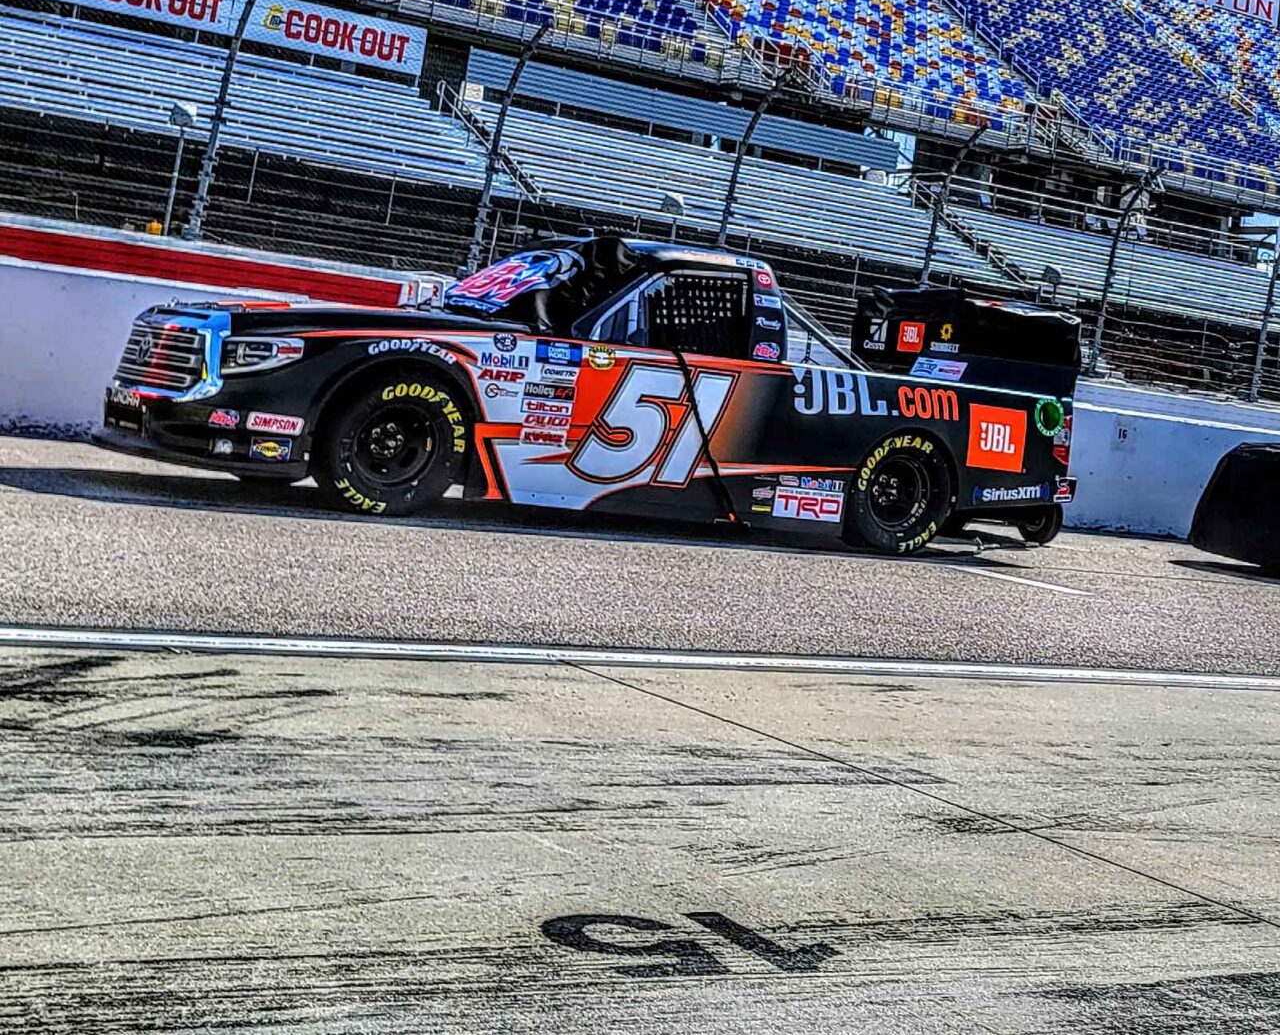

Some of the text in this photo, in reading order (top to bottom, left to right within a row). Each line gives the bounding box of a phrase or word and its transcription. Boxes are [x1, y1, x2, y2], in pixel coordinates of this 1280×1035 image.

[284, 9, 410, 63] COOK OUT
[903, 326, 920, 344] JBL
[368, 339, 456, 365] GOODYEAR
[481, 352, 515, 369] Mobil
[478, 368, 525, 383] ARP
[525, 383, 555, 399] Holley
[381, 382, 465, 453] GOODYEAR
[526, 401, 569, 414] tilton
[251, 416, 299, 432] SIMPSON
[565, 358, 740, 489] 51
[980, 421, 1016, 454] JBL
[858, 435, 934, 491] GOODYEAR
[335, 476, 387, 514] EAGLE
[777, 494, 841, 519] TRD
[898, 520, 938, 553] EAGLE
